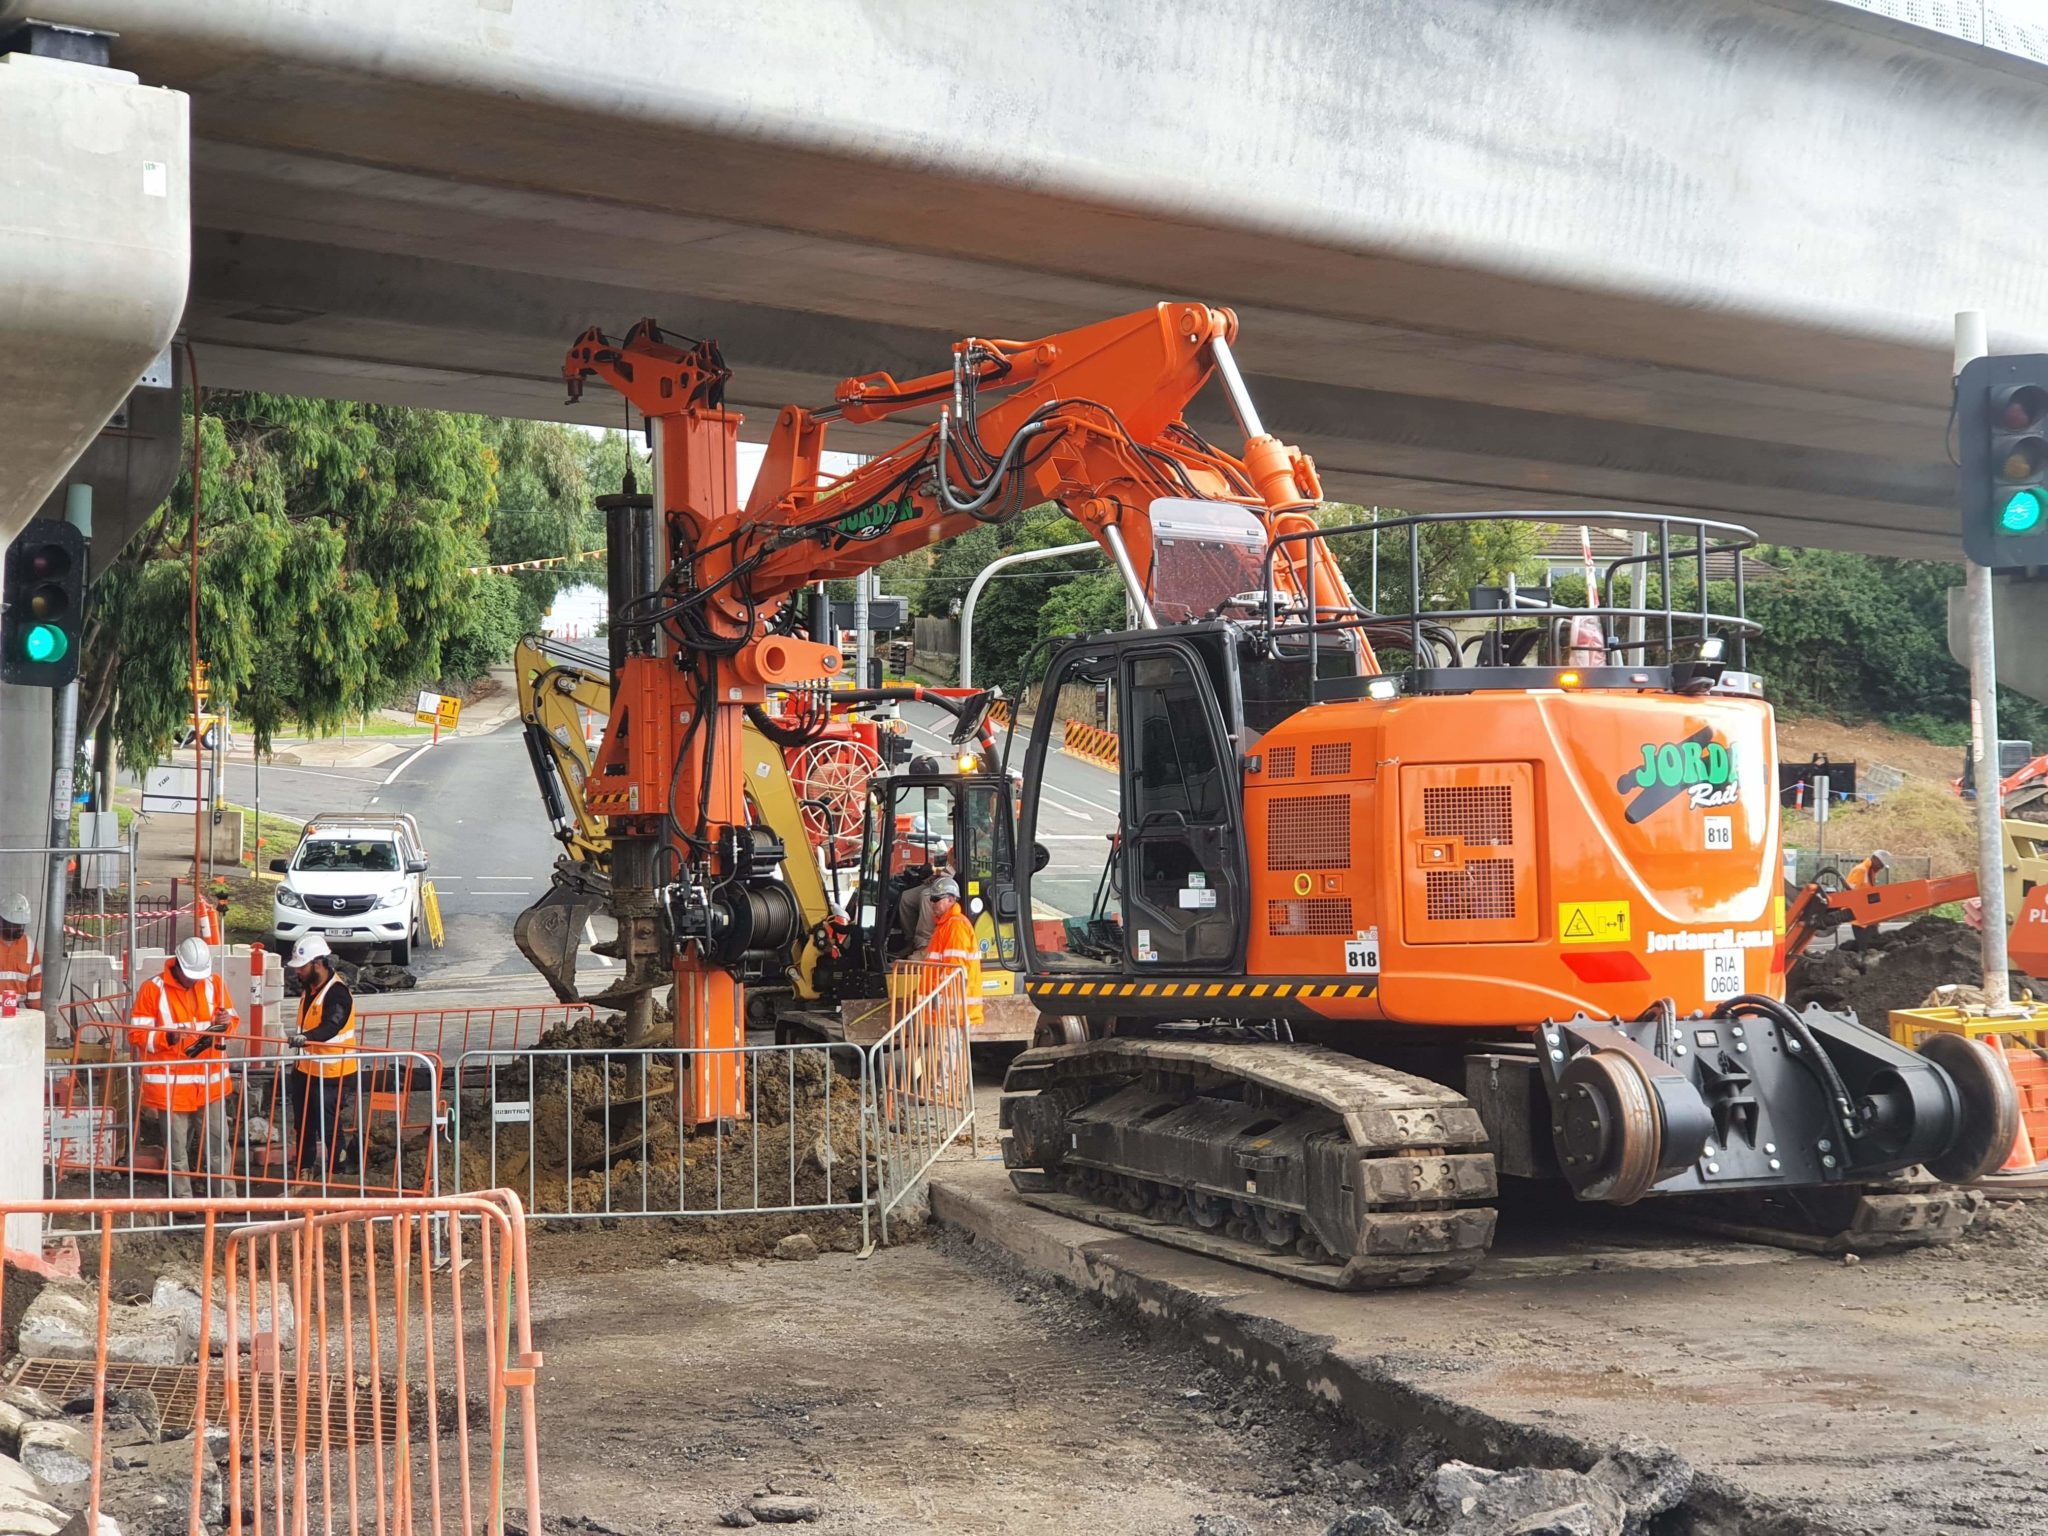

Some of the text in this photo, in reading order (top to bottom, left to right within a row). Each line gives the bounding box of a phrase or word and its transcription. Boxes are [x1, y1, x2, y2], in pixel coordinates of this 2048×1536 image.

[1635, 742, 1743, 788] JORDA
[1688, 780, 1739, 811] Rail
[1707, 827, 1730, 844] 818
[1348, 951, 1378, 967] 818
[1714, 956, 1737, 973] RIA
[1710, 976, 1740, 994] 0608
